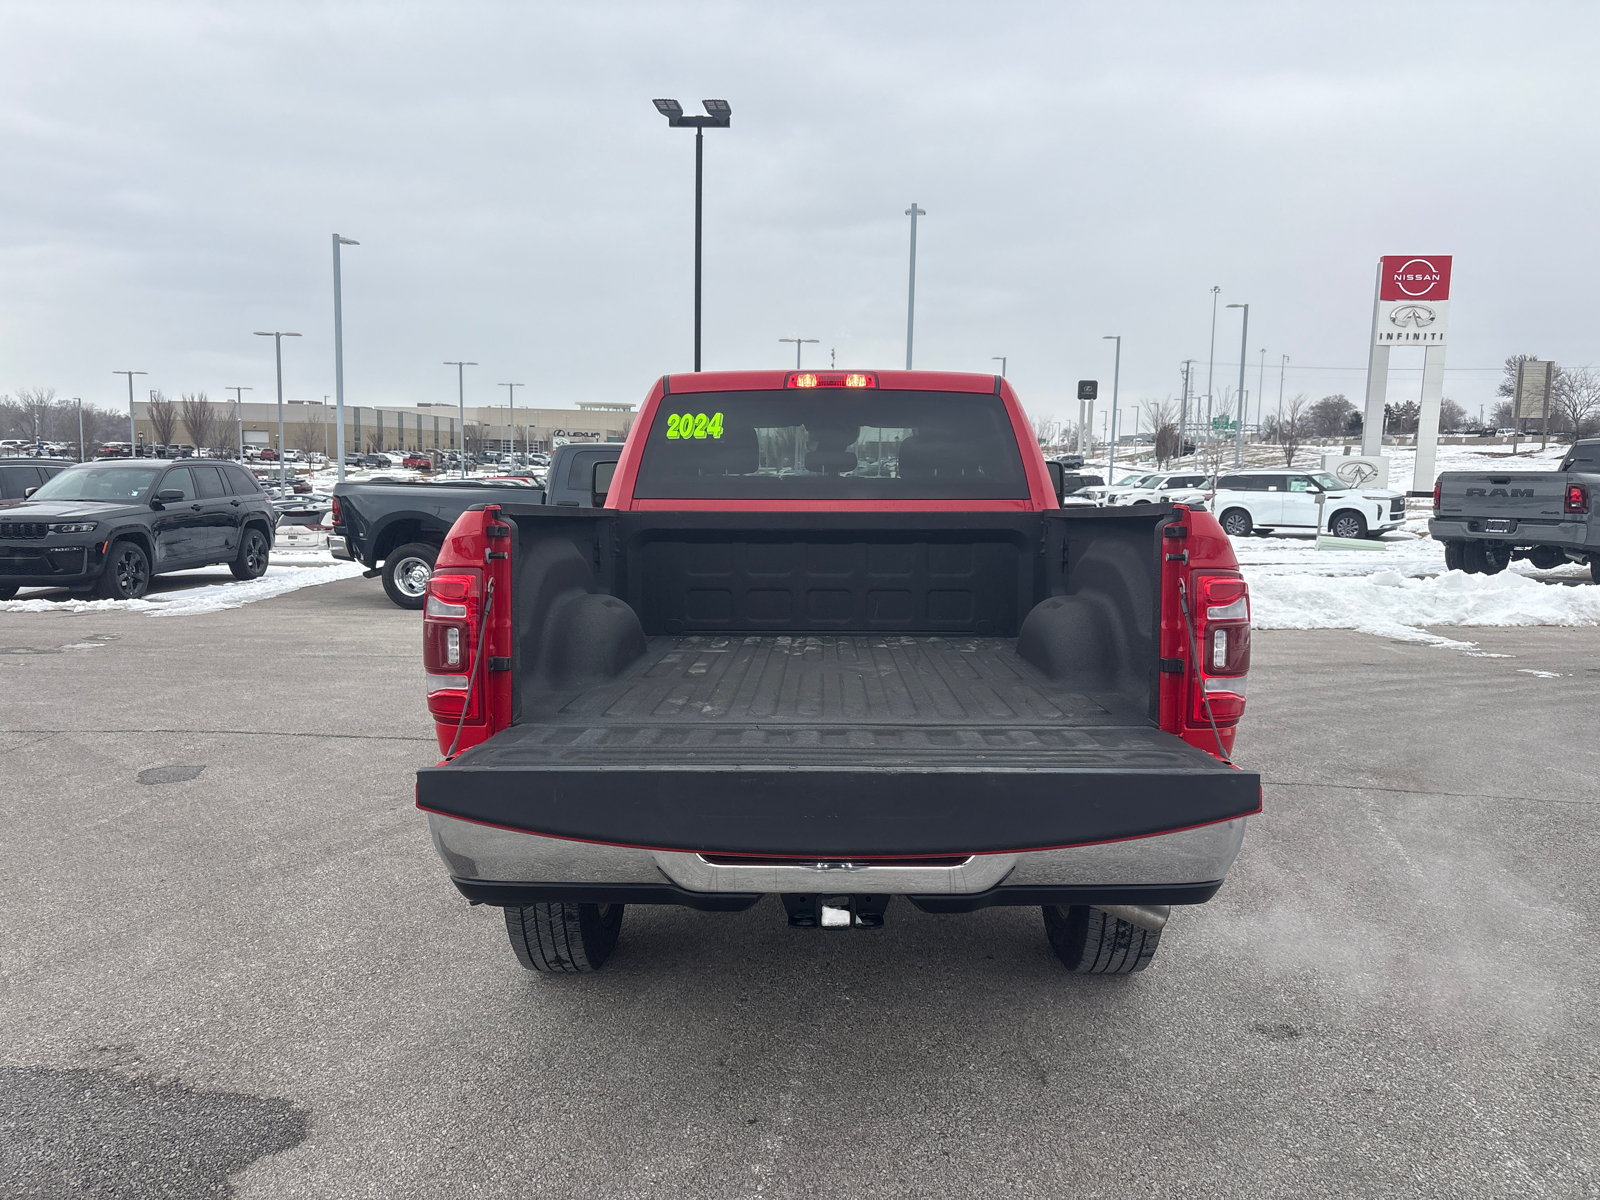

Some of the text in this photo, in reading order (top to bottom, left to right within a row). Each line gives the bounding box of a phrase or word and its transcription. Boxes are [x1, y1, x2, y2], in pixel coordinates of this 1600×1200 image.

[1379, 332, 1443, 340] INFINITI
[666, 412, 724, 440] 2024
[1466, 487, 1535, 498] RAM
